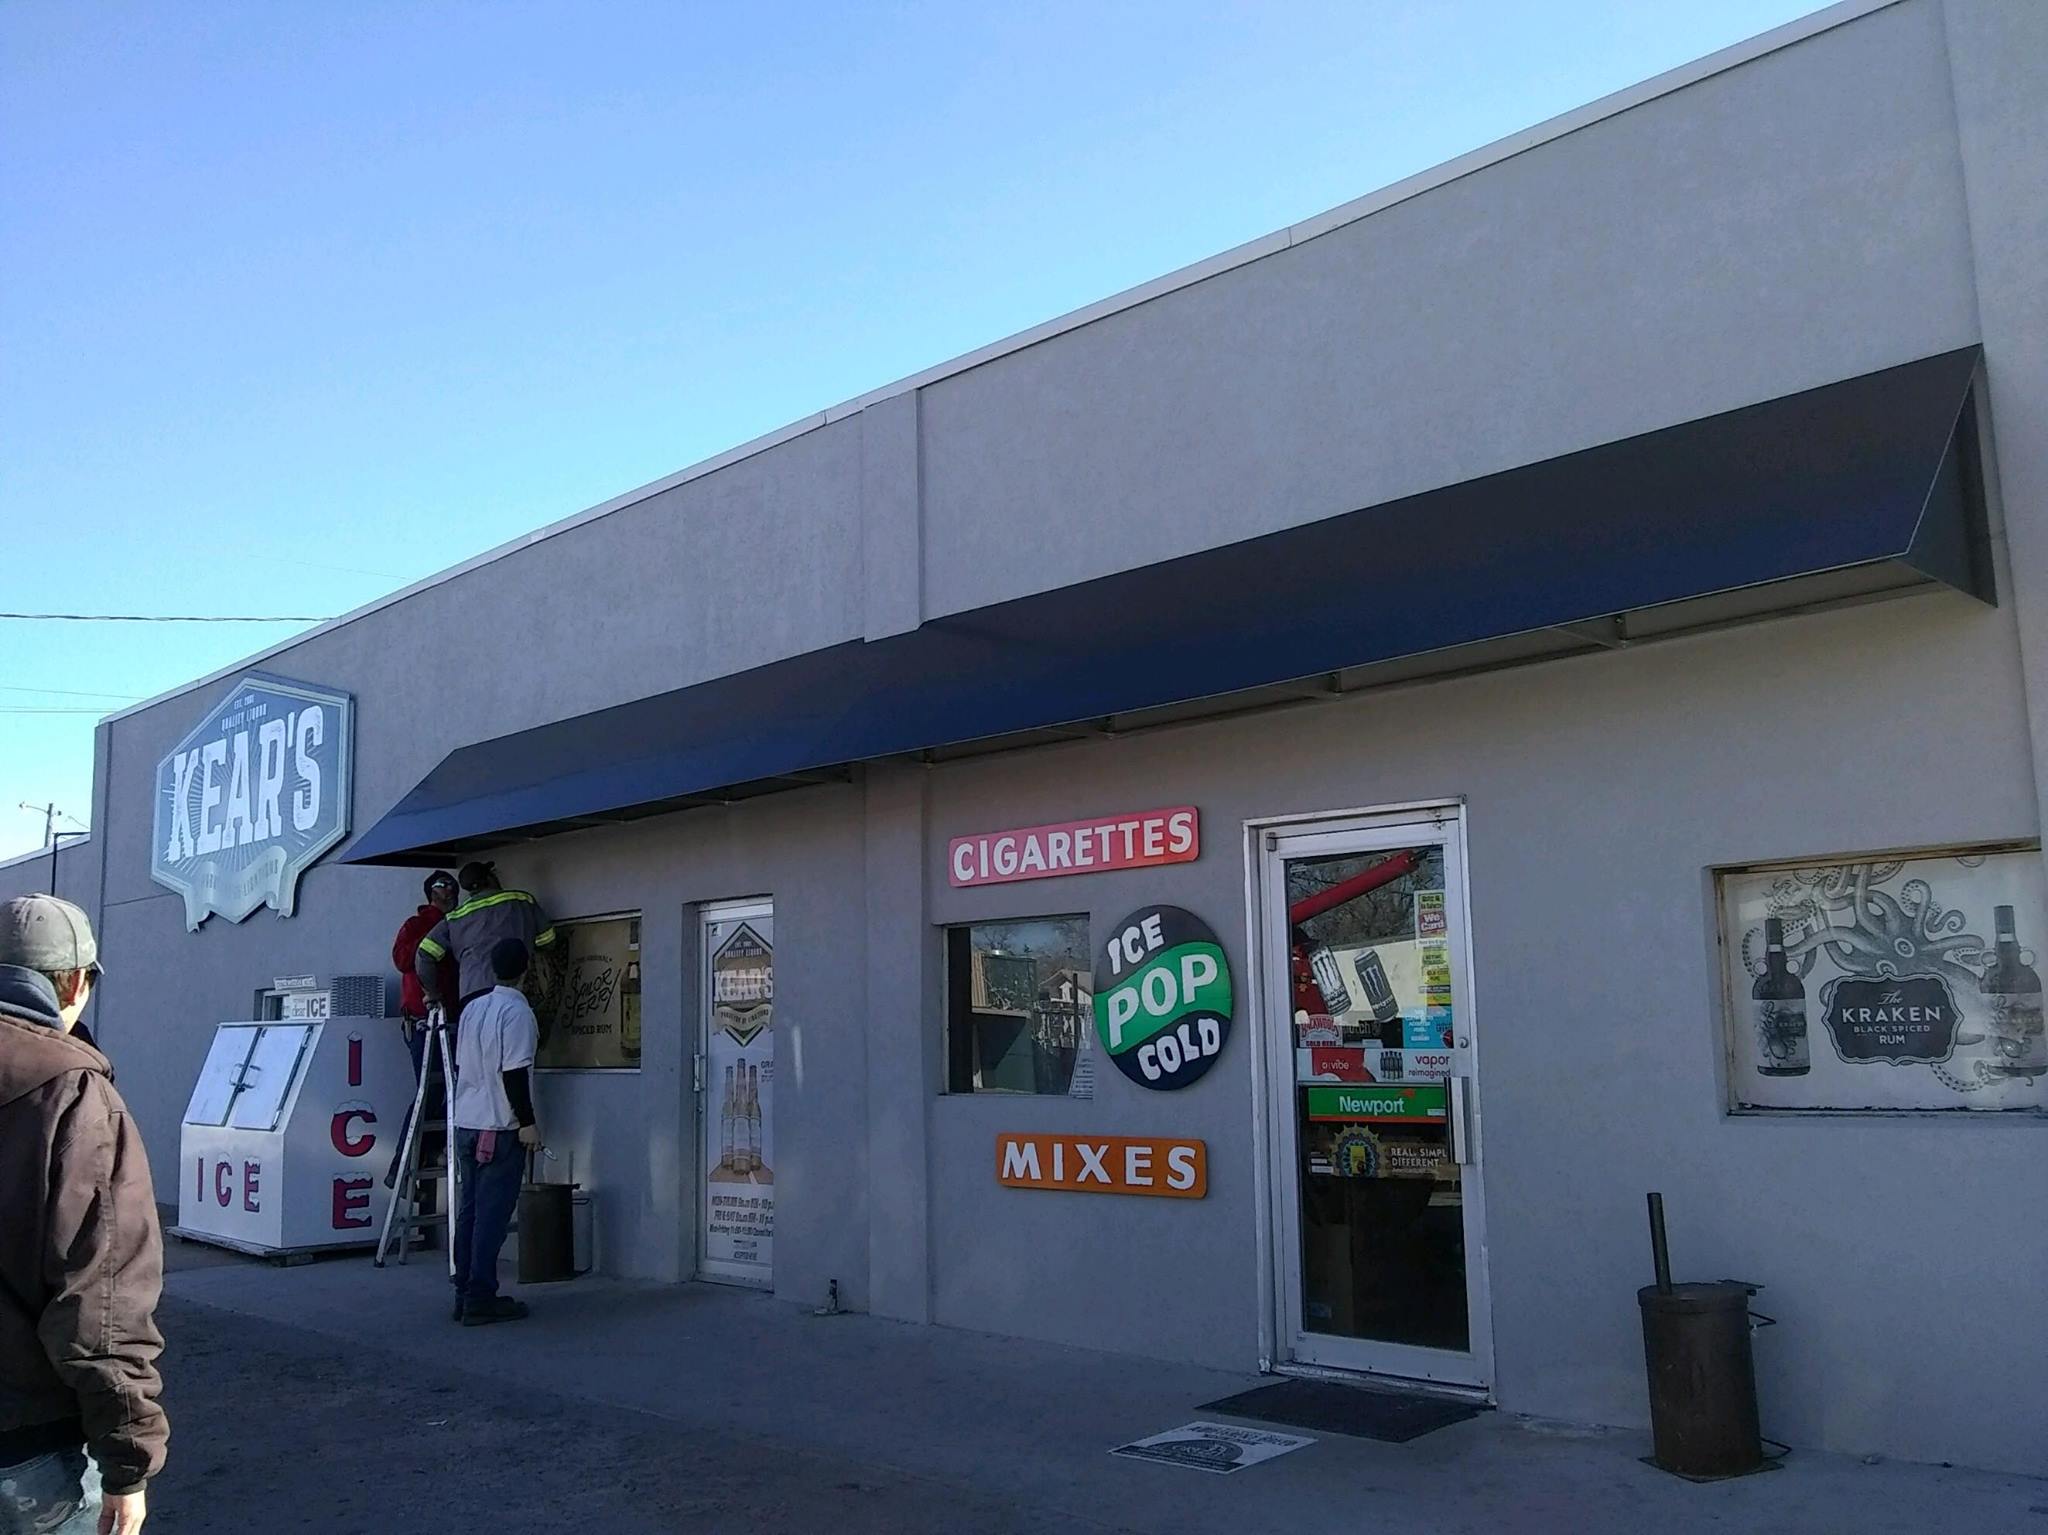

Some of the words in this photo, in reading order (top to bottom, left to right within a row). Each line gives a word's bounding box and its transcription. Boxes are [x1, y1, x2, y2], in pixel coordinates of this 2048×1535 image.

[167, 705, 323, 863] KEAR'S
[953, 812, 1193, 882] CIGARETTES
[1107, 913, 1165, 975] ICE
[306, 997, 327, 1018] ICE
[1108, 953, 1218, 1049] POP
[1842, 1006, 1941, 1023] KRAKEN
[1854, 1025, 1888, 1033] BLACK
[1879, 1034, 1905, 1045] RUM
[1137, 1018, 1221, 1081] COLD
[1415, 1055, 1450, 1069] vapor
[1408, 1068, 1450, 1079] reimagined
[1339, 1096, 1405, 1116] Newport
[329, 1030, 378, 1230] ICE
[1391, 1147, 1417, 1157] REAL.
[1391, 1157, 1442, 1168] DIFFERENT.
[1002, 1141, 1196, 1190] MIXES
[197, 1152, 261, 1213] ICE
